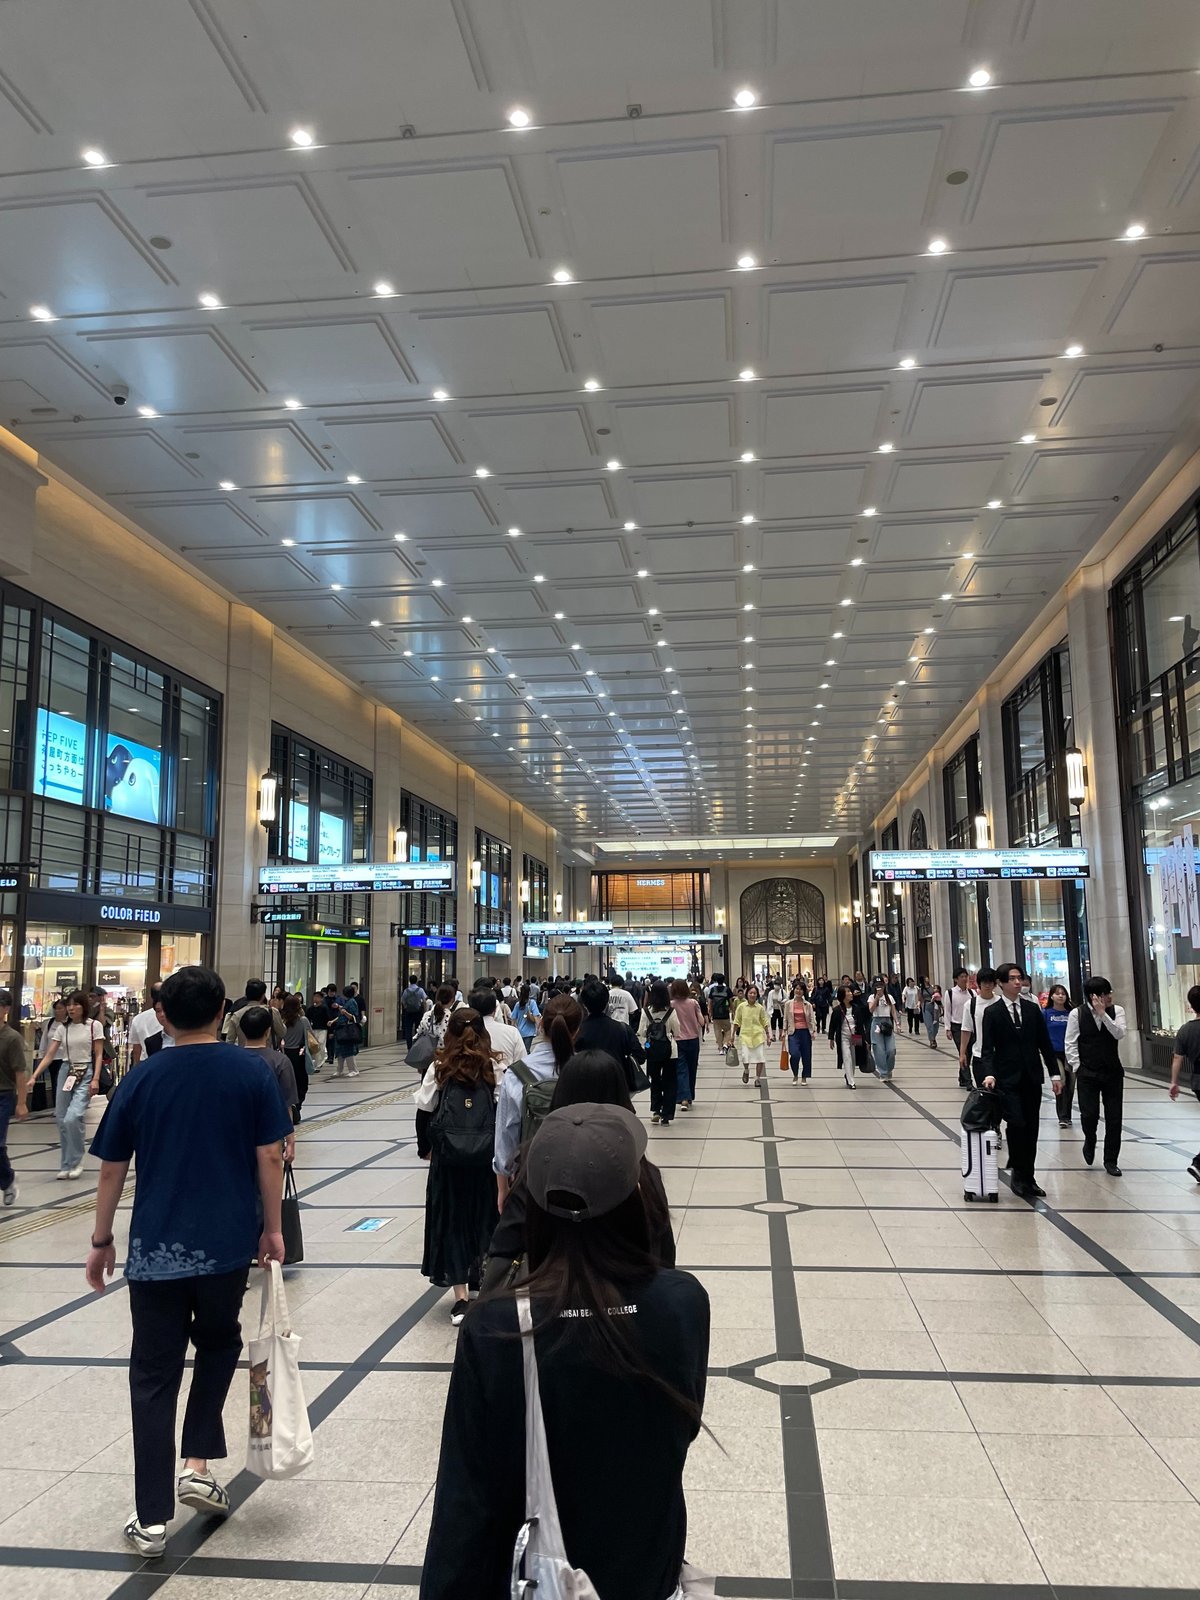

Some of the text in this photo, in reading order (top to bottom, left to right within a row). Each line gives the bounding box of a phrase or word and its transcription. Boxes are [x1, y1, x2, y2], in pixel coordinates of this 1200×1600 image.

[60, 735, 78, 750] FIVE
[100, 905, 133, 921] COLOR
[607, 1304, 638, 1316] COLLEGE
